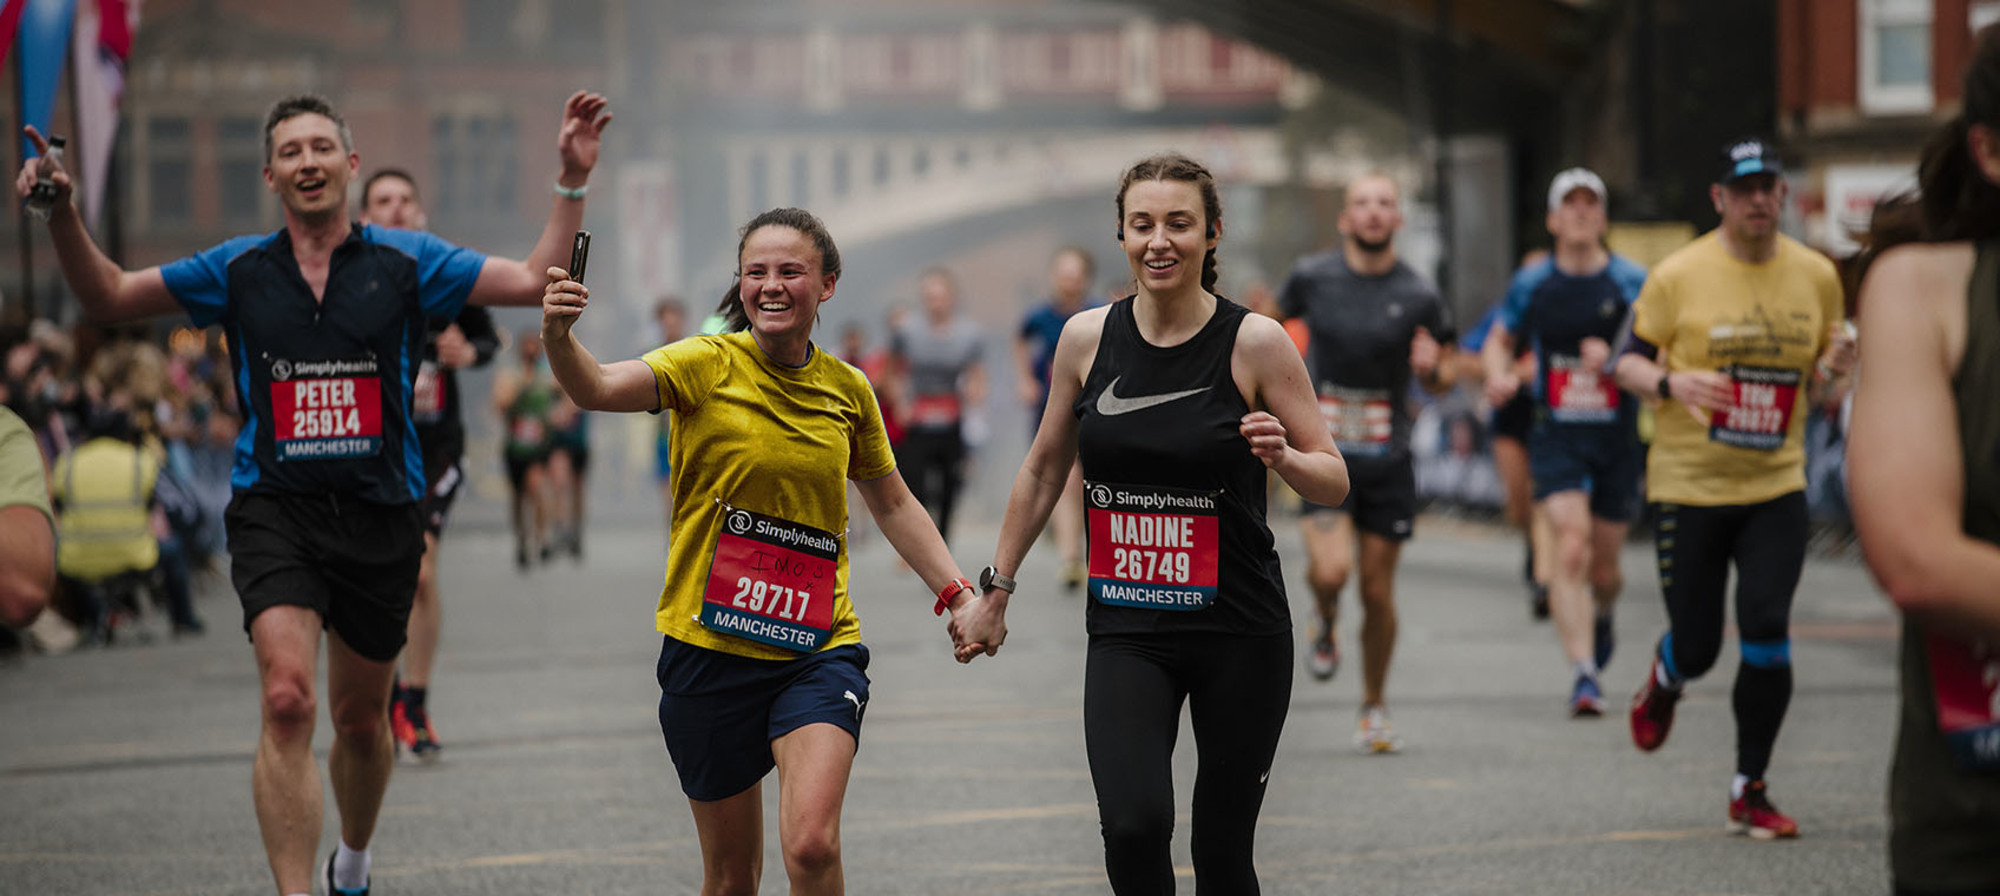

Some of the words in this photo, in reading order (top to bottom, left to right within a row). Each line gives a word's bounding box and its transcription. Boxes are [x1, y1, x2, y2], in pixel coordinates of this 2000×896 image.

[295, 360, 377, 376] Simplyhealth
[295, 379, 356, 408] PETER
[294, 408, 361, 438] 25914
[285, 439, 371, 456] MANCHESTER
[1116, 491, 1215, 510] Simplyhealth
[755, 520, 837, 553] Simplyhealth
[1110, 513, 1195, 548] NADINE
[1114, 548, 1190, 583] 26749
[732, 576, 811, 622] 29717
[1102, 584, 1203, 605] MANCHESTER
[714, 611, 816, 647] MANCHESTER
